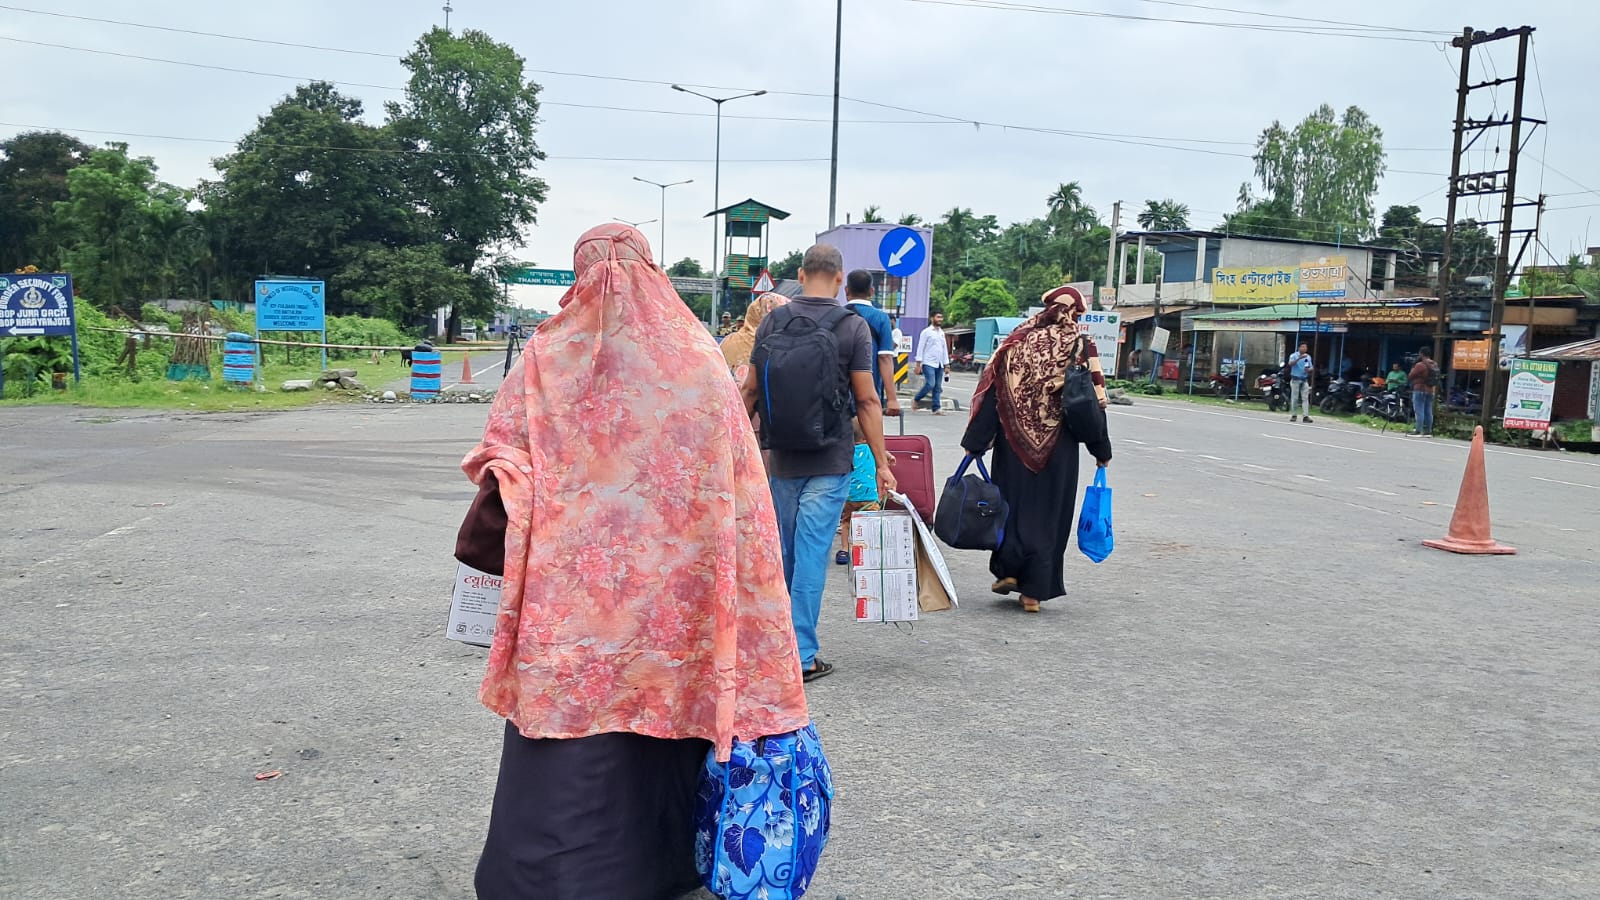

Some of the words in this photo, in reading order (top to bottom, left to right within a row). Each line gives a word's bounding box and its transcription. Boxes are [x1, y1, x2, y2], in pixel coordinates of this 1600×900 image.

[1216, 271, 1237, 286] সিংহ
[1240, 270, 1291, 287] এন্টারপ্রাইজ
[17, 278, 55, 292] SECURITY
[51, 288, 68, 309] FORCE
[0, 309, 15, 318] BOP
[41, 309, 67, 318] GACH
[0, 318, 14, 328] BOP
[16, 318, 70, 326] NARAYANJOTE
[1085, 315, 1105, 323] BSF
